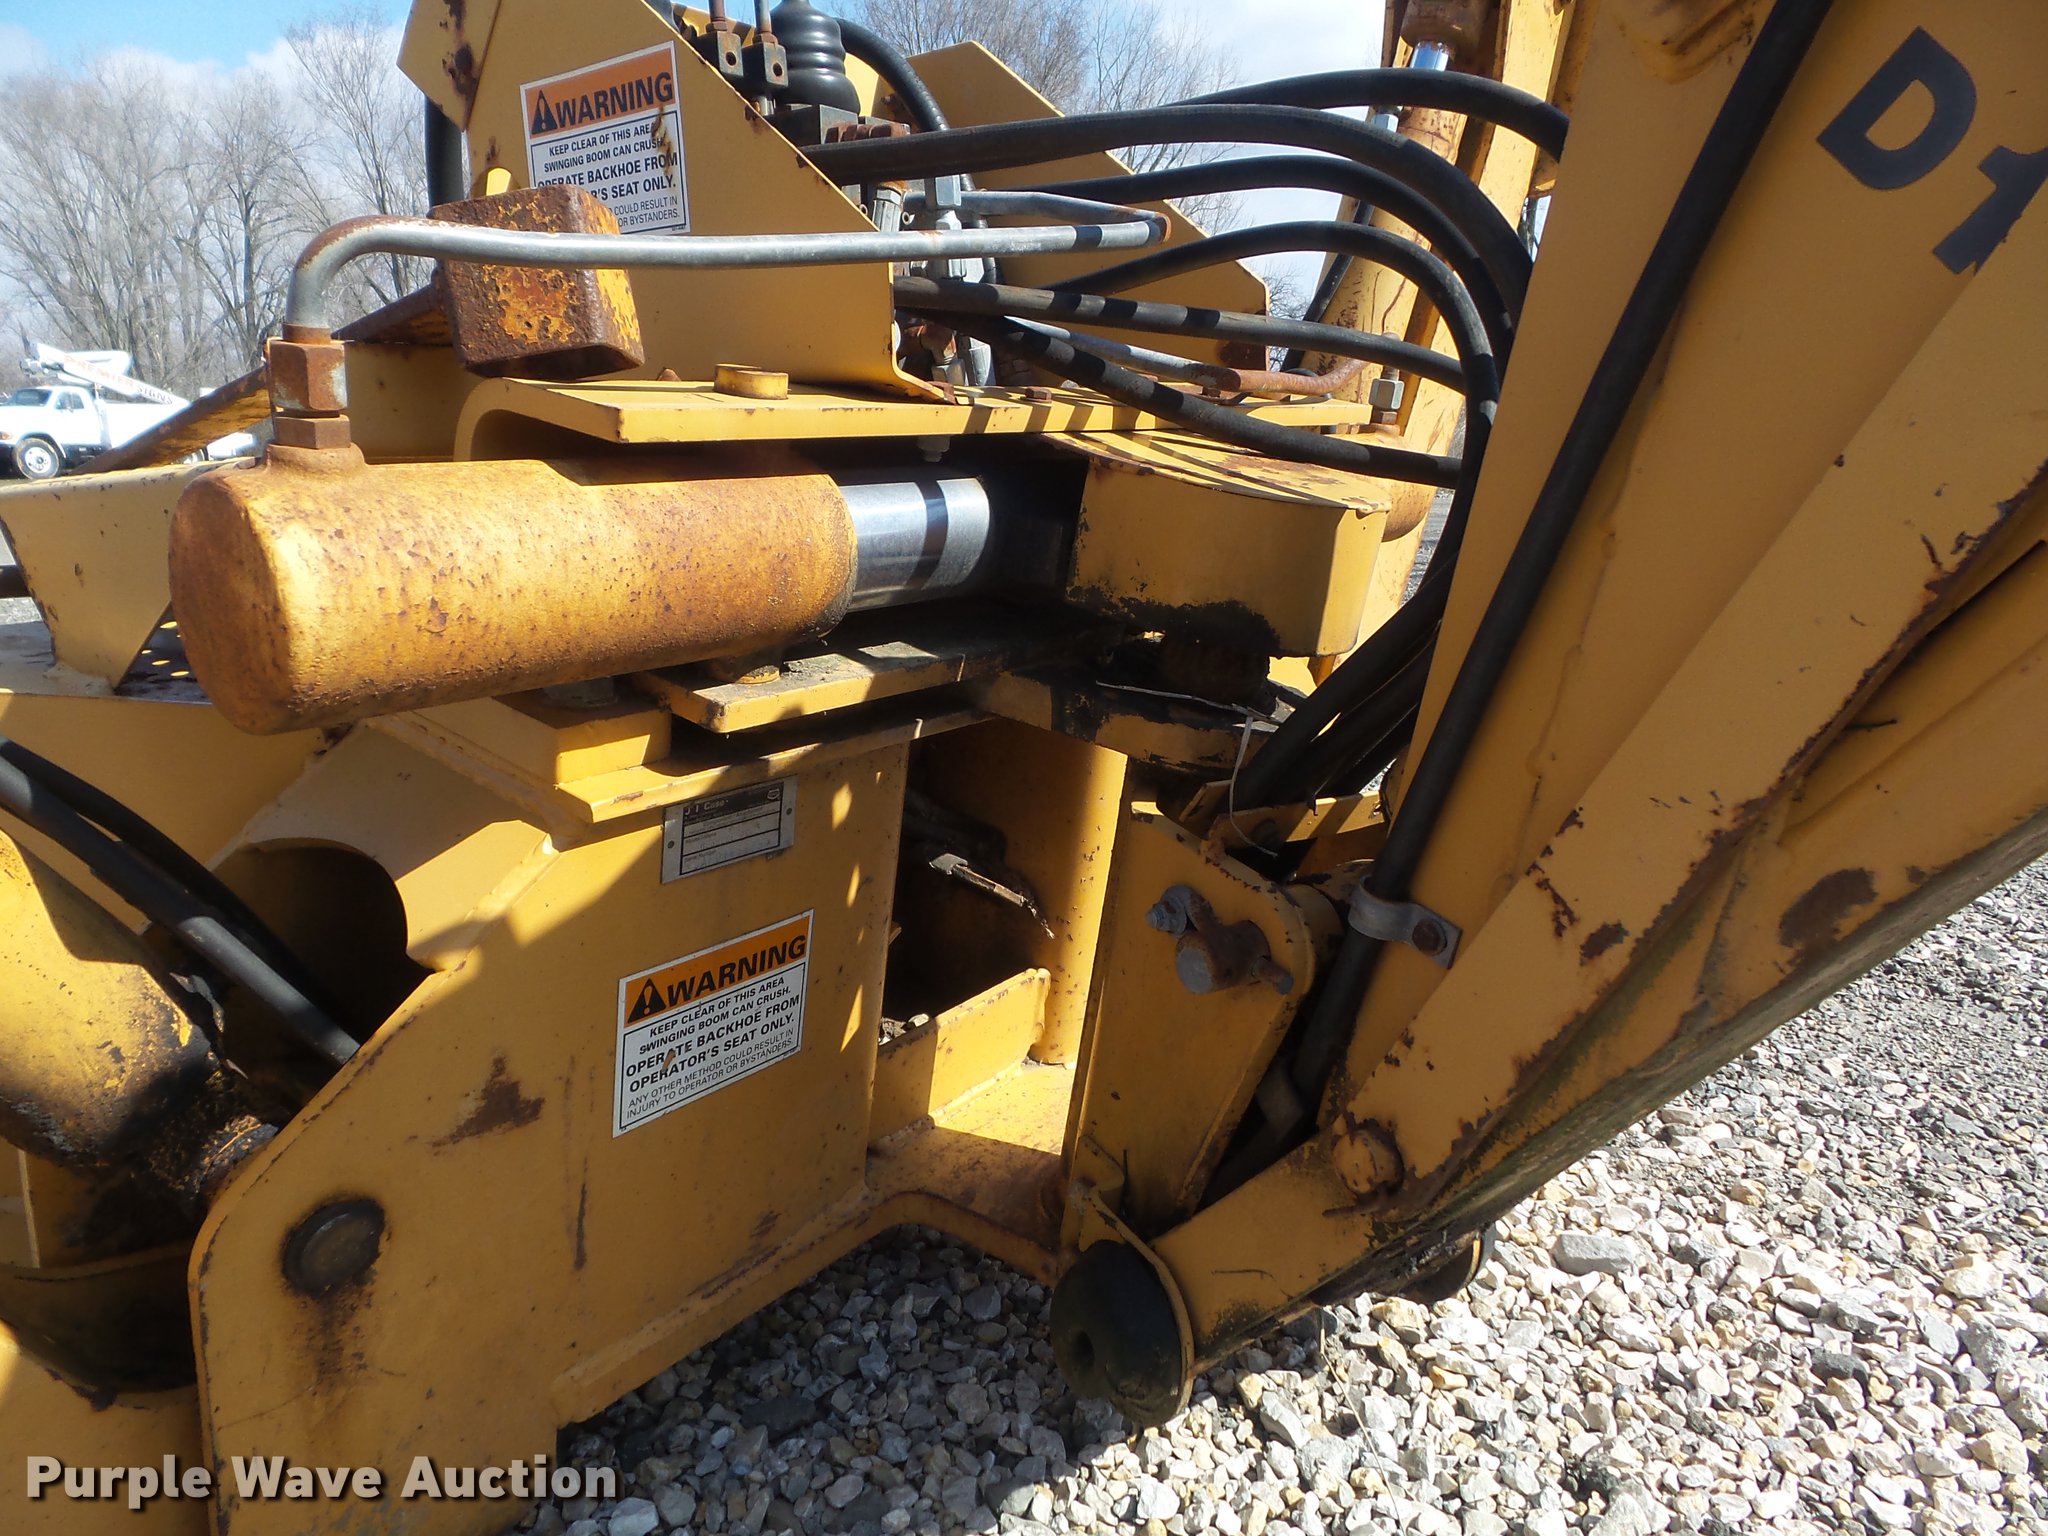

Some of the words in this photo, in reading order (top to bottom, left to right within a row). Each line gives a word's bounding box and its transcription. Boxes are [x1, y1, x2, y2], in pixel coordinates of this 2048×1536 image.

[555, 72, 673, 128] WARNING
[544, 155, 584, 173] SWINGING
[586, 150, 611, 163] BOOM
[613, 144, 631, 158] CAN
[549, 144, 569, 157] KEEP
[571, 138, 597, 152] CLEAR
[599, 133, 611, 145] OF
[612, 128, 631, 142] THIS
[588, 160, 641, 184] BACKHOE
[644, 152, 678, 171] FROM
[611, 181, 639, 199] SEAT
[643, 174, 676, 192] ONLY.
[614, 202, 639, 216] COULD
[640, 196, 668, 211] RESULT
[670, 195, 678, 206] IN
[137, 384, 173, 405] SIGNS
[666, 935, 806, 1007] WARNING
[639, 1025, 695, 1055] SWINGING
[698, 1011, 729, 1031] BOOM
[732, 1001, 754, 1016] CAN
[756, 986, 791, 1006] CRUSH.
[649, 1019, 679, 1038] KEEP
[681, 1004, 715, 1025] CLEAR
[718, 997, 731, 1010] OF
[734, 988, 756, 1004] THIS
[759, 976, 785, 994] AREA
[696, 1010, 762, 1048] BACKHOE
[765, 994, 800, 1018] FROM
[628, 1092, 649, 1109] ANY
[651, 1078, 682, 1098] OTHER
[684, 1060, 722, 1084] METHOD
[723, 1046, 753, 1066] COULD
[754, 1031, 785, 1052] RESULT
[785, 1027, 794, 1038] IN
[629, 1045, 720, 1093] OPERATOR'S
[723, 1028, 758, 1052] SEAT
[760, 1012, 795, 1036] ONLY.
[626, 1098, 662, 1120] INJURY
[663, 1090, 676, 1103] TO
[678, 1069, 724, 1096] OPERATOR
[725, 1062, 738, 1075] OR
